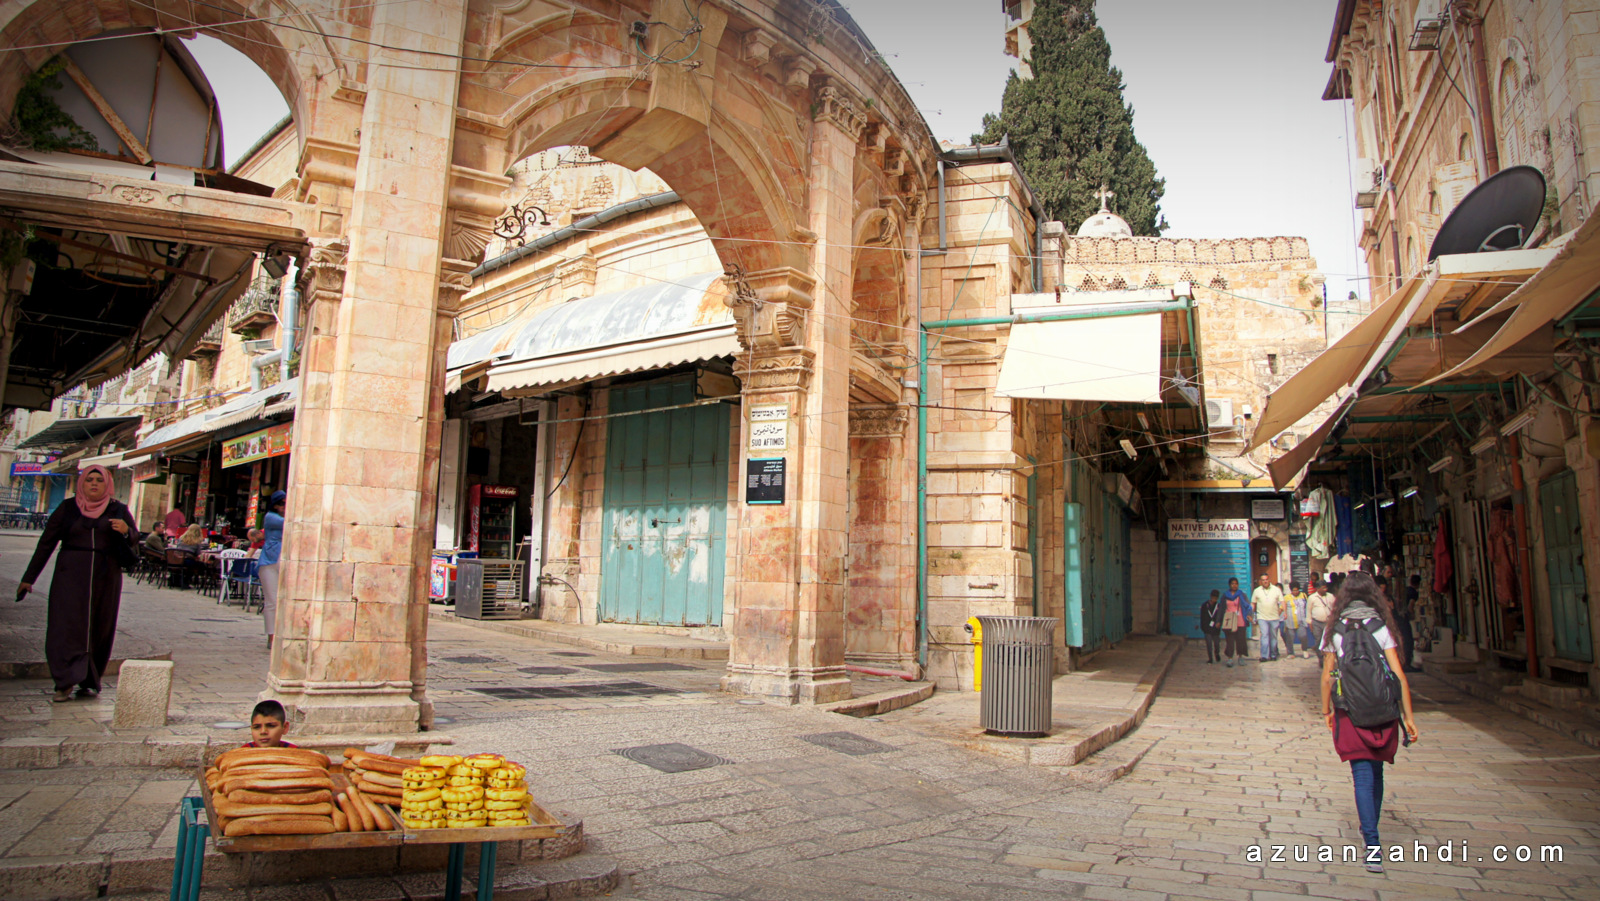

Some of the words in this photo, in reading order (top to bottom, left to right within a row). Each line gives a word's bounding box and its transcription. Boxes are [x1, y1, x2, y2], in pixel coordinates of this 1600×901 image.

[763, 437, 785, 446] AFTIMOS
[494, 486, 517, 495] Coca-Cola
[1171, 523, 1204, 532] NATIVE
[1208, 523, 1245, 532] BAZAAR
